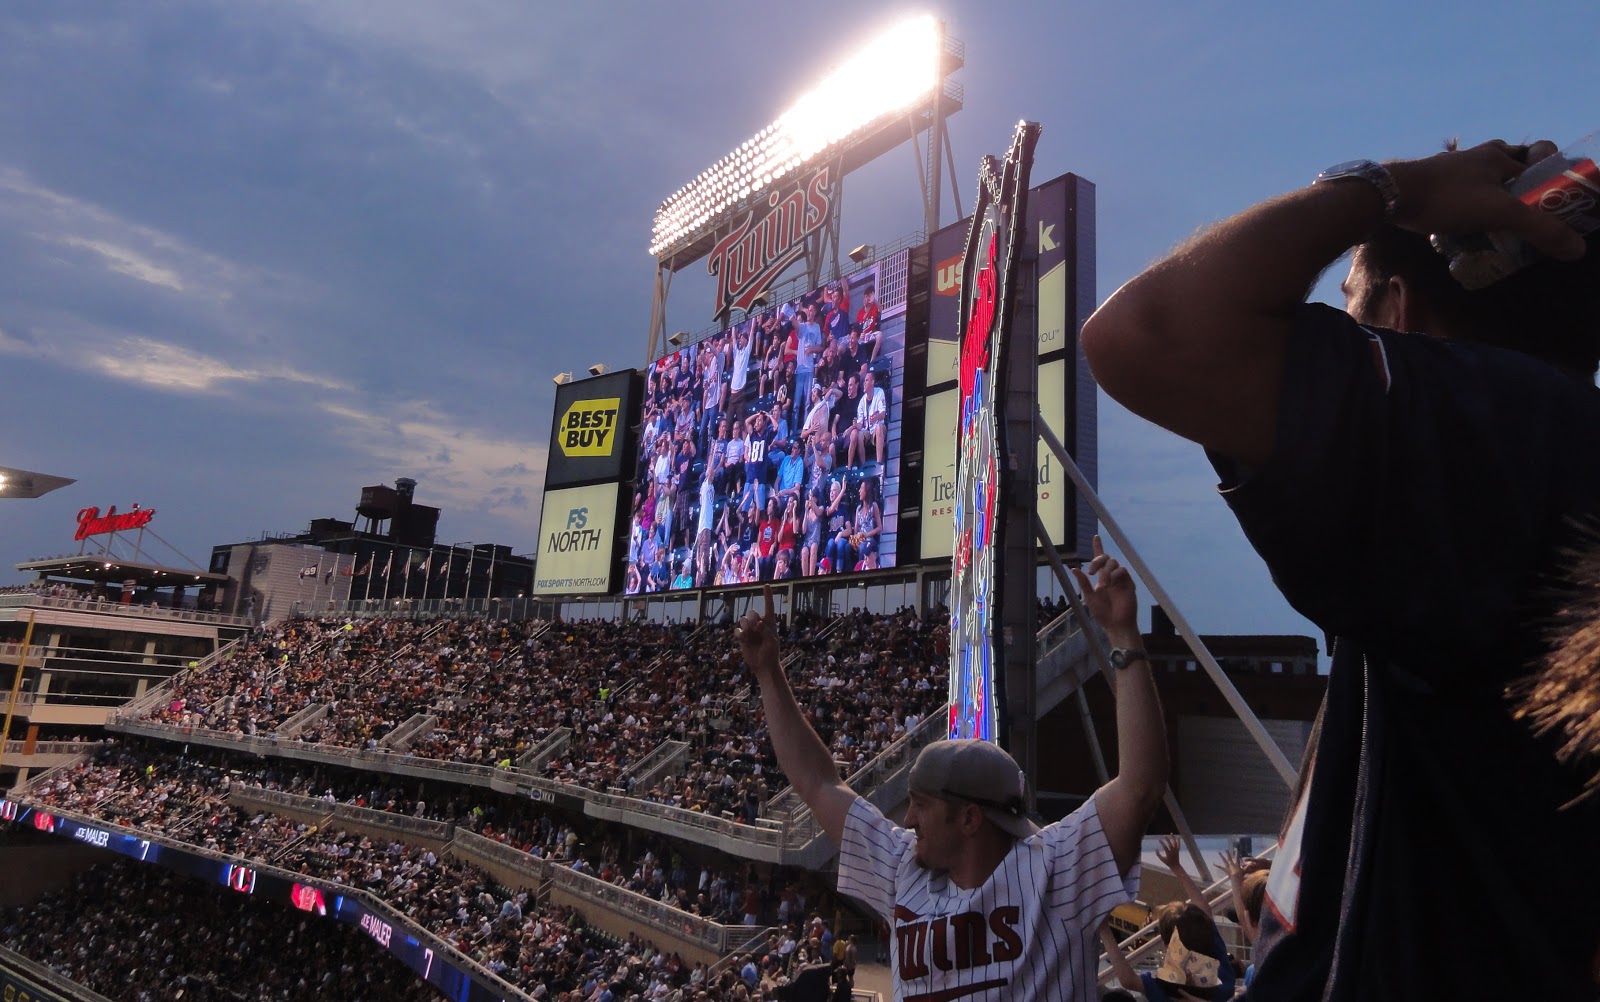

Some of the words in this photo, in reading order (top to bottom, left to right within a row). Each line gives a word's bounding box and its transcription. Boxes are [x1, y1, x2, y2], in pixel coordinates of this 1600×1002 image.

[707, 167, 829, 314] Twins
[567, 409, 617, 429] BEST
[565, 428, 609, 448] BUY
[751, 440, 765, 462] 81
[567, 507, 588, 529] FS
[547, 528, 601, 553] NORTH
[85, 827, 110, 847] MAUER
[141, 840, 150, 861] 7
[369, 915, 392, 948] MAUER
[424, 947, 433, 979] 7
